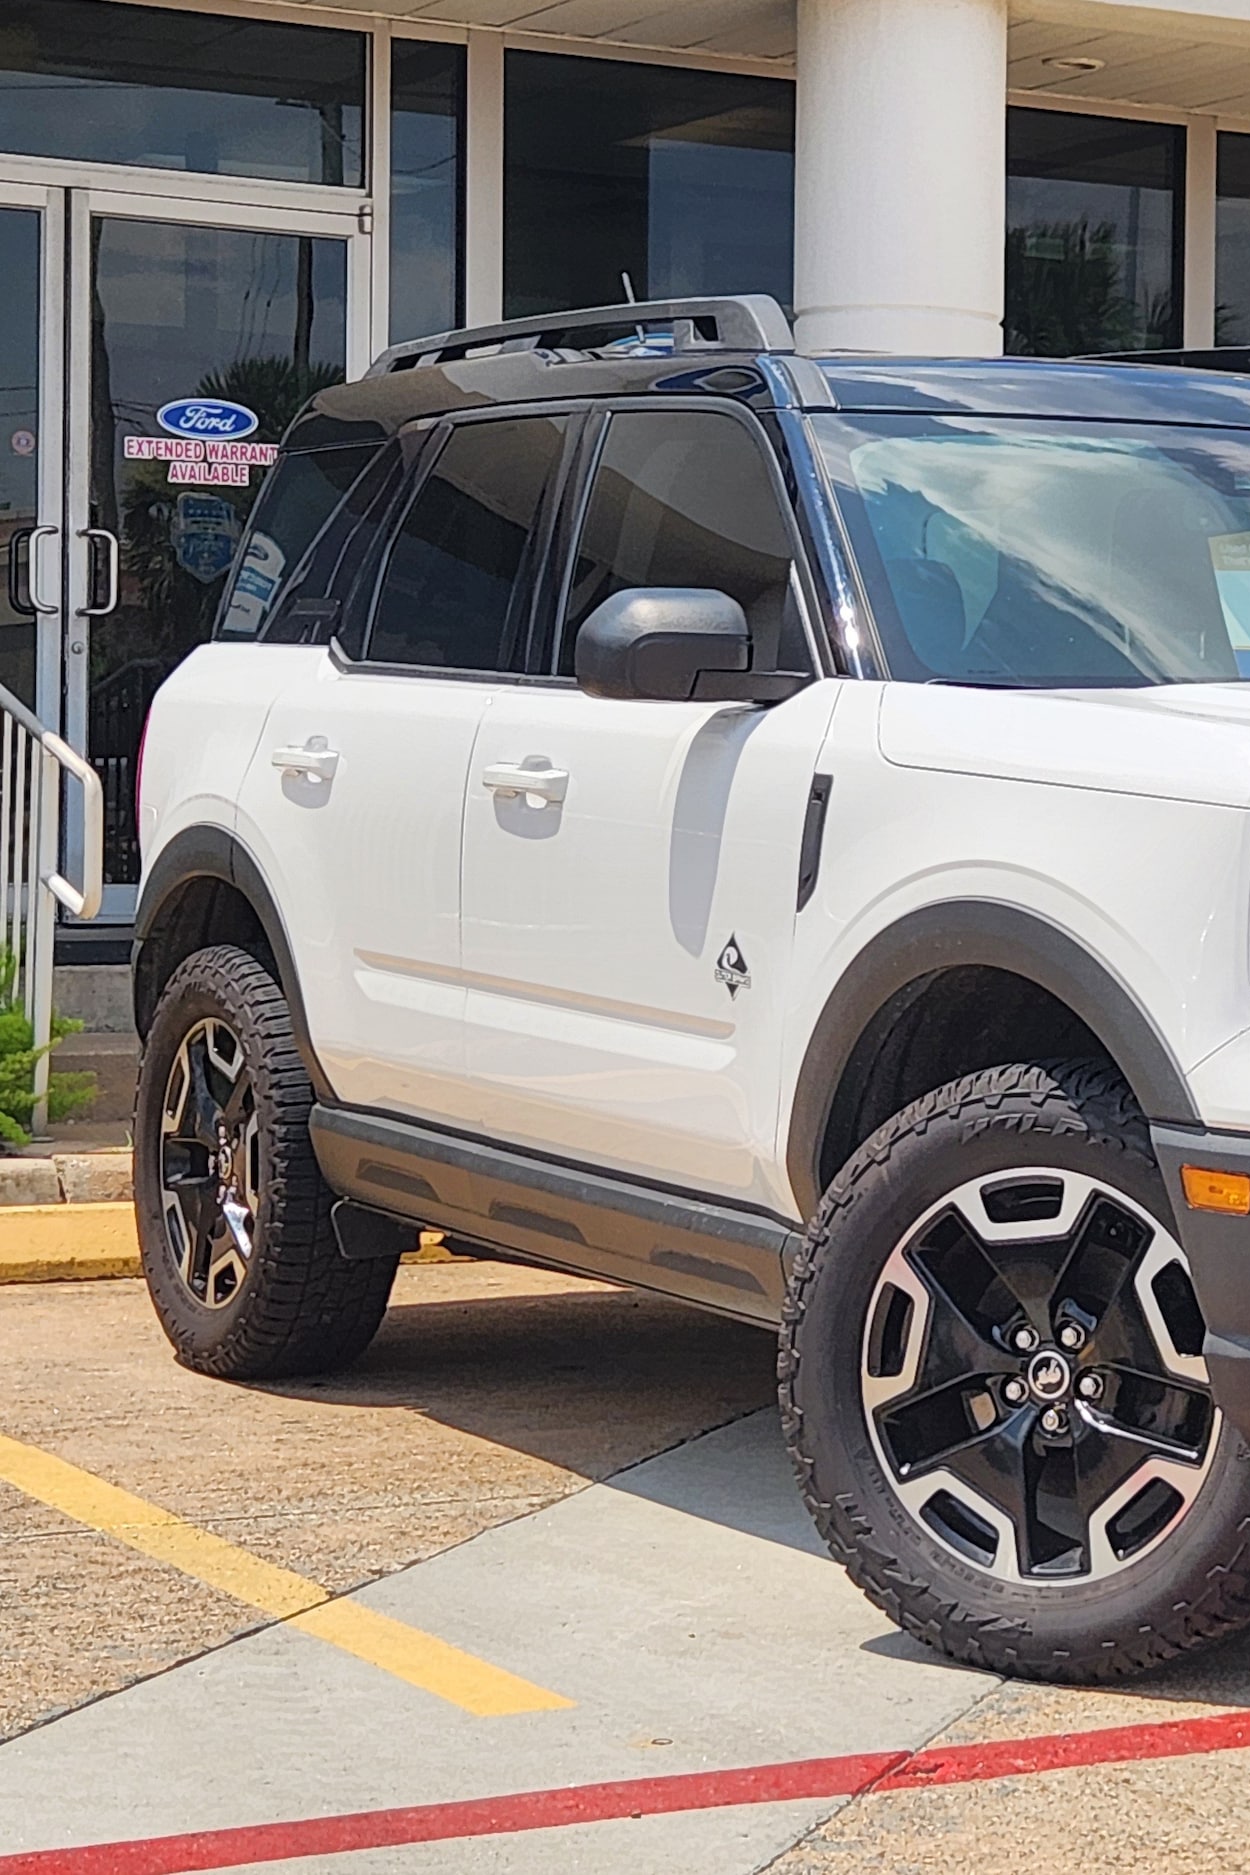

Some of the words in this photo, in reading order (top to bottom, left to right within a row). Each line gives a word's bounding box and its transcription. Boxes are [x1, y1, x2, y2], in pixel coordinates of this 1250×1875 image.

[179, 405, 238, 432] Ford
[126, 438, 203, 459] EXTENDED
[207, 443, 278, 463] WARRANT
[170, 463, 248, 484] AVAILABLE
